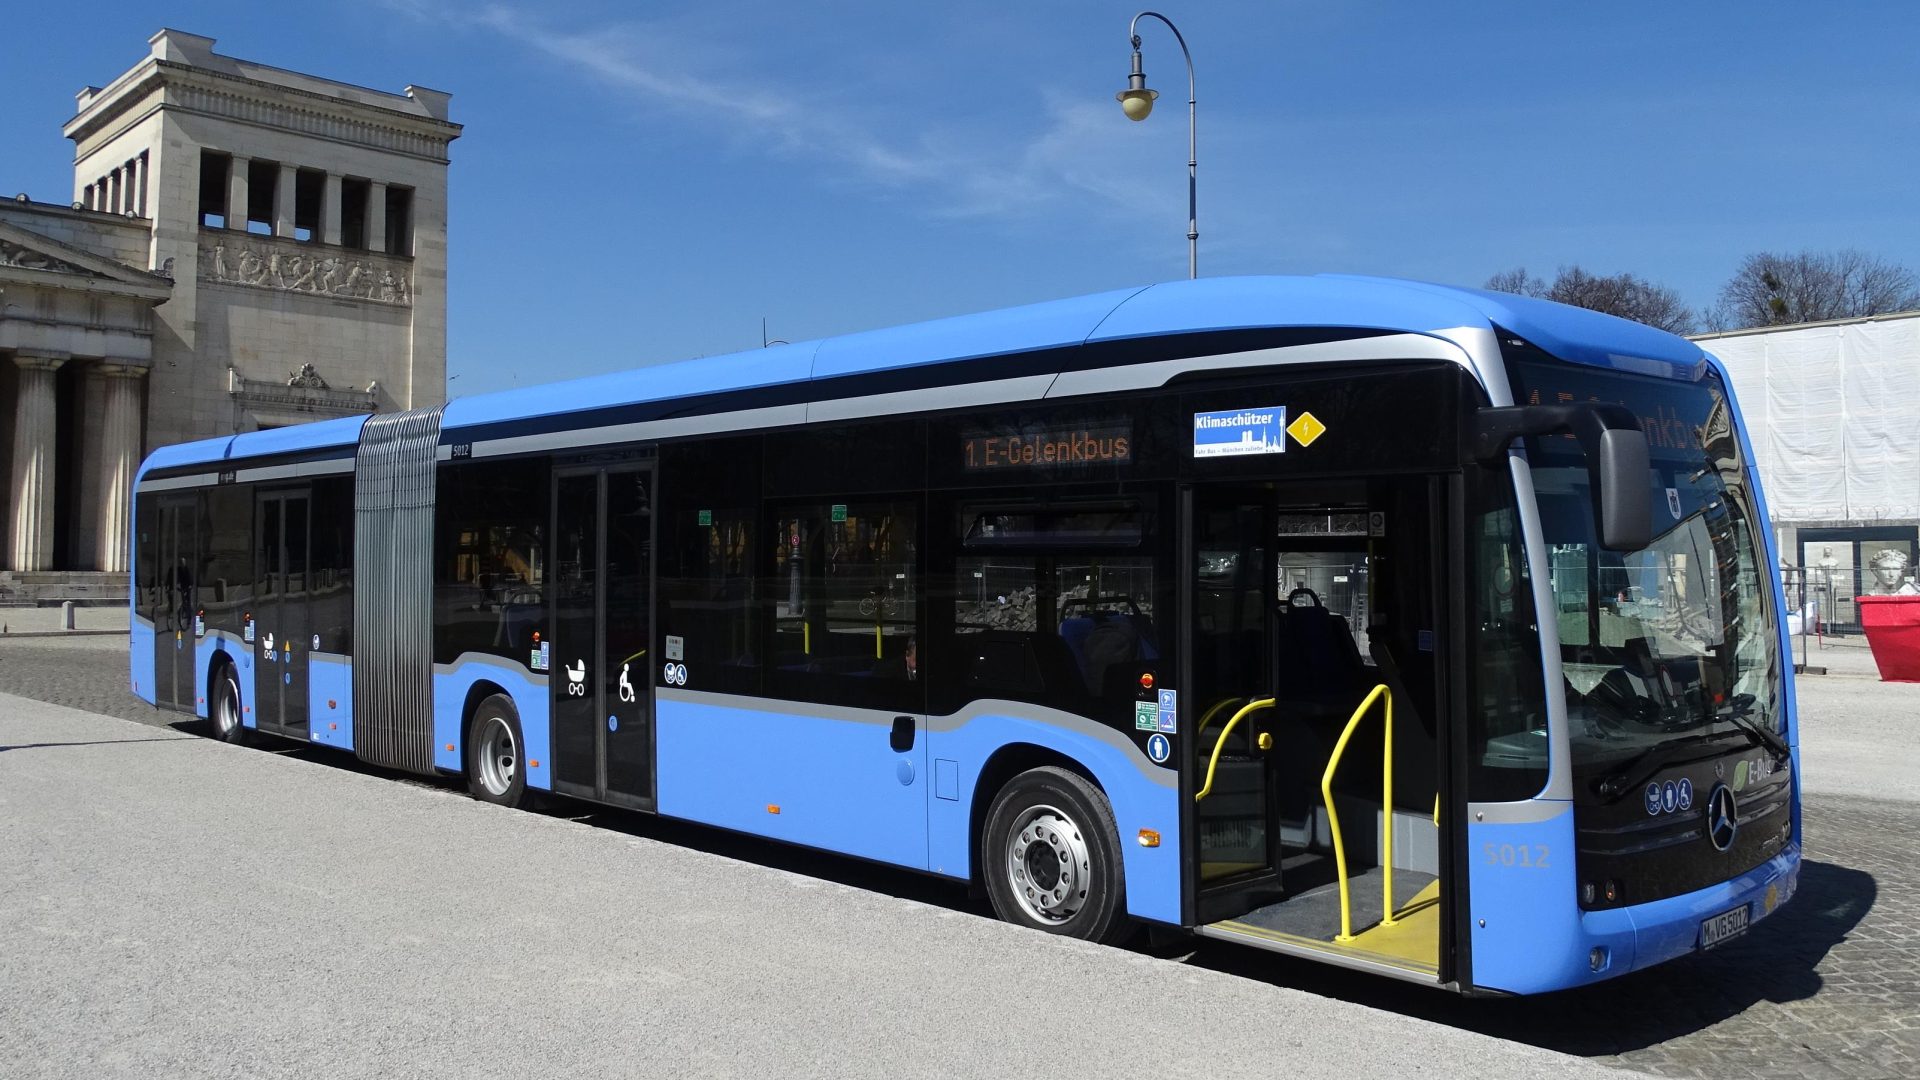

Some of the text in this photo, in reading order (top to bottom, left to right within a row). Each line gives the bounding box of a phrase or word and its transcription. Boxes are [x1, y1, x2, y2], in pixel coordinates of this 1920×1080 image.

[1196, 413, 1273, 429] Klimaschützer
[453, 444, 469, 457] 5012
[985, 431, 1130, 466] E-Gelenkbus
[1483, 843, 1551, 869] 5012
